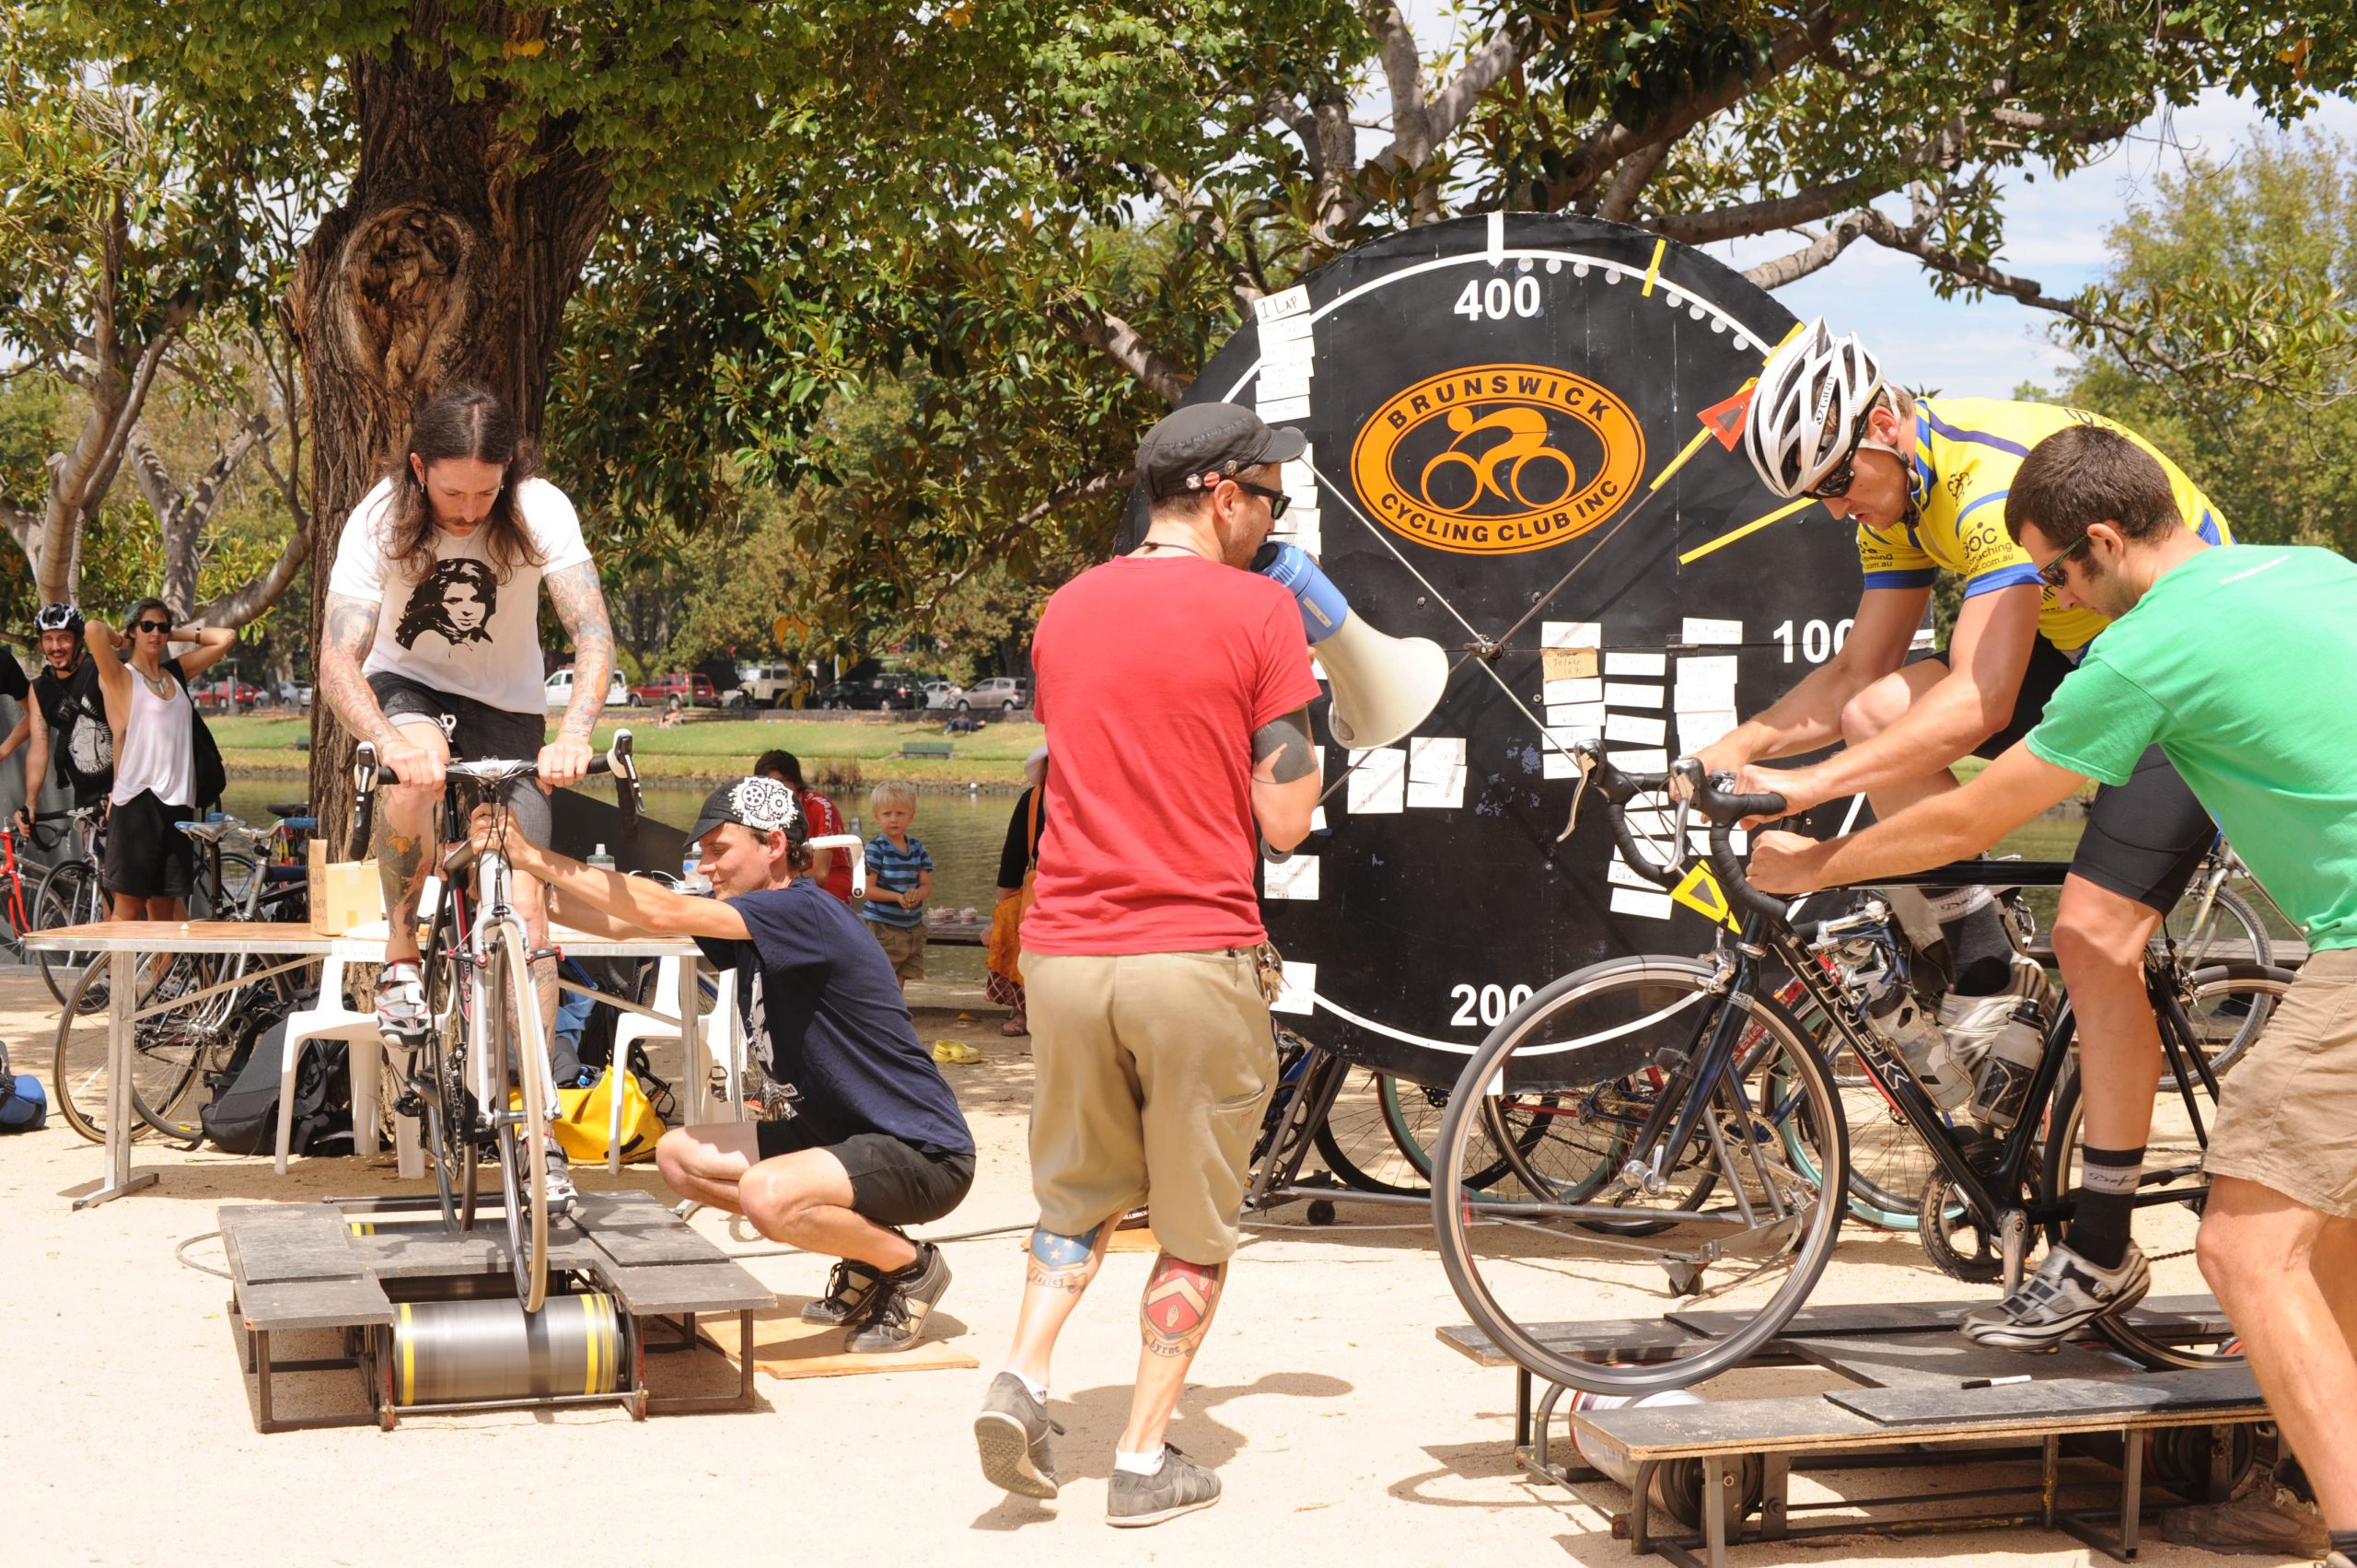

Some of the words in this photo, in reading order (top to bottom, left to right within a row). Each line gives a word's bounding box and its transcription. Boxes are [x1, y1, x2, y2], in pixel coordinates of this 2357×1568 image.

[1260, 301, 1270, 319] 1
[1454, 275, 1540, 320] 400
[1387, 375, 1610, 431] BRUNSWICK
[1380, 493, 1489, 542] CYCLING
[1497, 512, 1571, 542] CLUB
[1575, 480, 1619, 519] INC
[1797, 947, 1910, 1090] TREK
